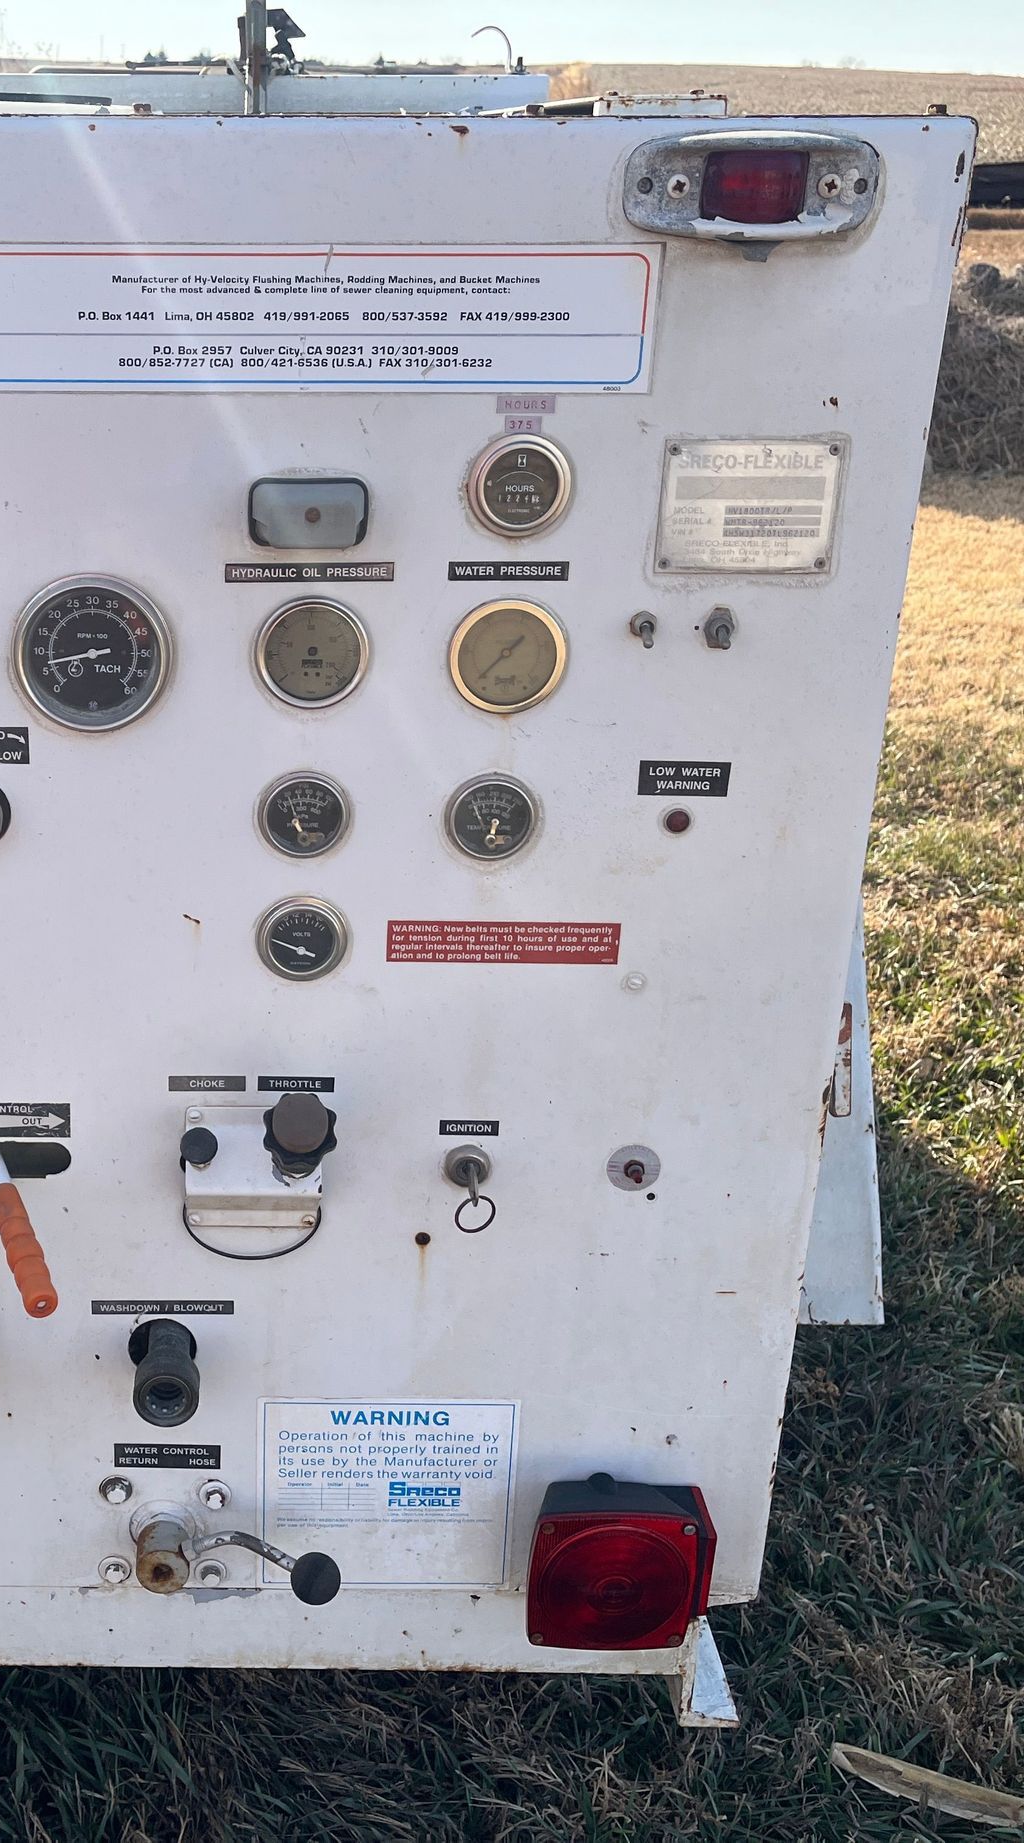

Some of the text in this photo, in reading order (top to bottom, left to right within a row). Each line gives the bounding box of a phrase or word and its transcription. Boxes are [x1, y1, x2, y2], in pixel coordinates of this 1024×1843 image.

[112, 275, 540, 287] Manufacturer of Hy-Velocity Flushing Machines, Rodding Machines, and Bucket Machines
[141, 286, 158, 294] For
[160, 286, 176, 294] the
[179, 286, 203, 294] most
[206, 286, 250, 294] advanced
[254, 286, 262, 294] &
[264, 286, 308, 296] complete
[311, 286, 328, 294] line
[330, 286, 340, 294] of
[375, 286, 414, 296] cleaning
[416, 286, 468, 296] equipment,
[78, 311, 570, 322] P.O. Box 1441 Lima, OH 45802 419/991-2065 800/537-3592 FAX 419/999-2300
[153, 346, 458, 357] P.O. Box 2957 Culver City, CA 90231 310/301-9009
[118, 358, 492, 368] 800/852-7727 (CA) 800/421-6536 (U.S.A.) FAX 310/301-6232
[505, 400, 547, 410] HOURS
[509, 420, 533, 430] 375
[679, 454, 823, 470] SRECO-FLEXIBLE
[505, 484, 535, 493] HOURS
[232, 567, 387, 578] HYDRAULIC OIL PRESSURE
[455, 566, 562, 576] WATER PRESSURE
[66, 600, 79, 608] 25
[86, 597, 99, 605] 30
[94, 664, 121, 673] TACH
[649, 767, 721, 778] LOW WATER
[656, 780, 711, 790] WARNING
[392, 924, 442, 933] WARNING:
[444, 925, 464, 933] New
[465, 925, 488, 933] belts
[527, 926, 565, 934] checked
[567, 926, 613, 936] frequently
[189, 1079, 225, 1088] CHOKE
[269, 1079, 322, 1089] THROTTLE
[22, 1117, 43, 1125] OUT
[446, 1124, 492, 1133] IGNITION
[174, 1304, 224, 1312] BLOWOUT
[330, 1410, 450, 1426] WARNING
[278, 1430, 499, 1444] Operation of this machine by
[162, 1447, 210, 1455] CONTROL
[278, 1444, 498, 1456] persons not properly trained in
[189, 1458, 216, 1466] HOSE
[278, 1456, 498, 1468] its use by the Manufacturer or
[278, 1468, 318, 1478] Seller
[321, 1469, 374, 1479] renders
[377, 1469, 398, 1479] the
[401, 1470, 462, 1481] warranty
[388, 1498, 460, 1507] FLEXIBLE
